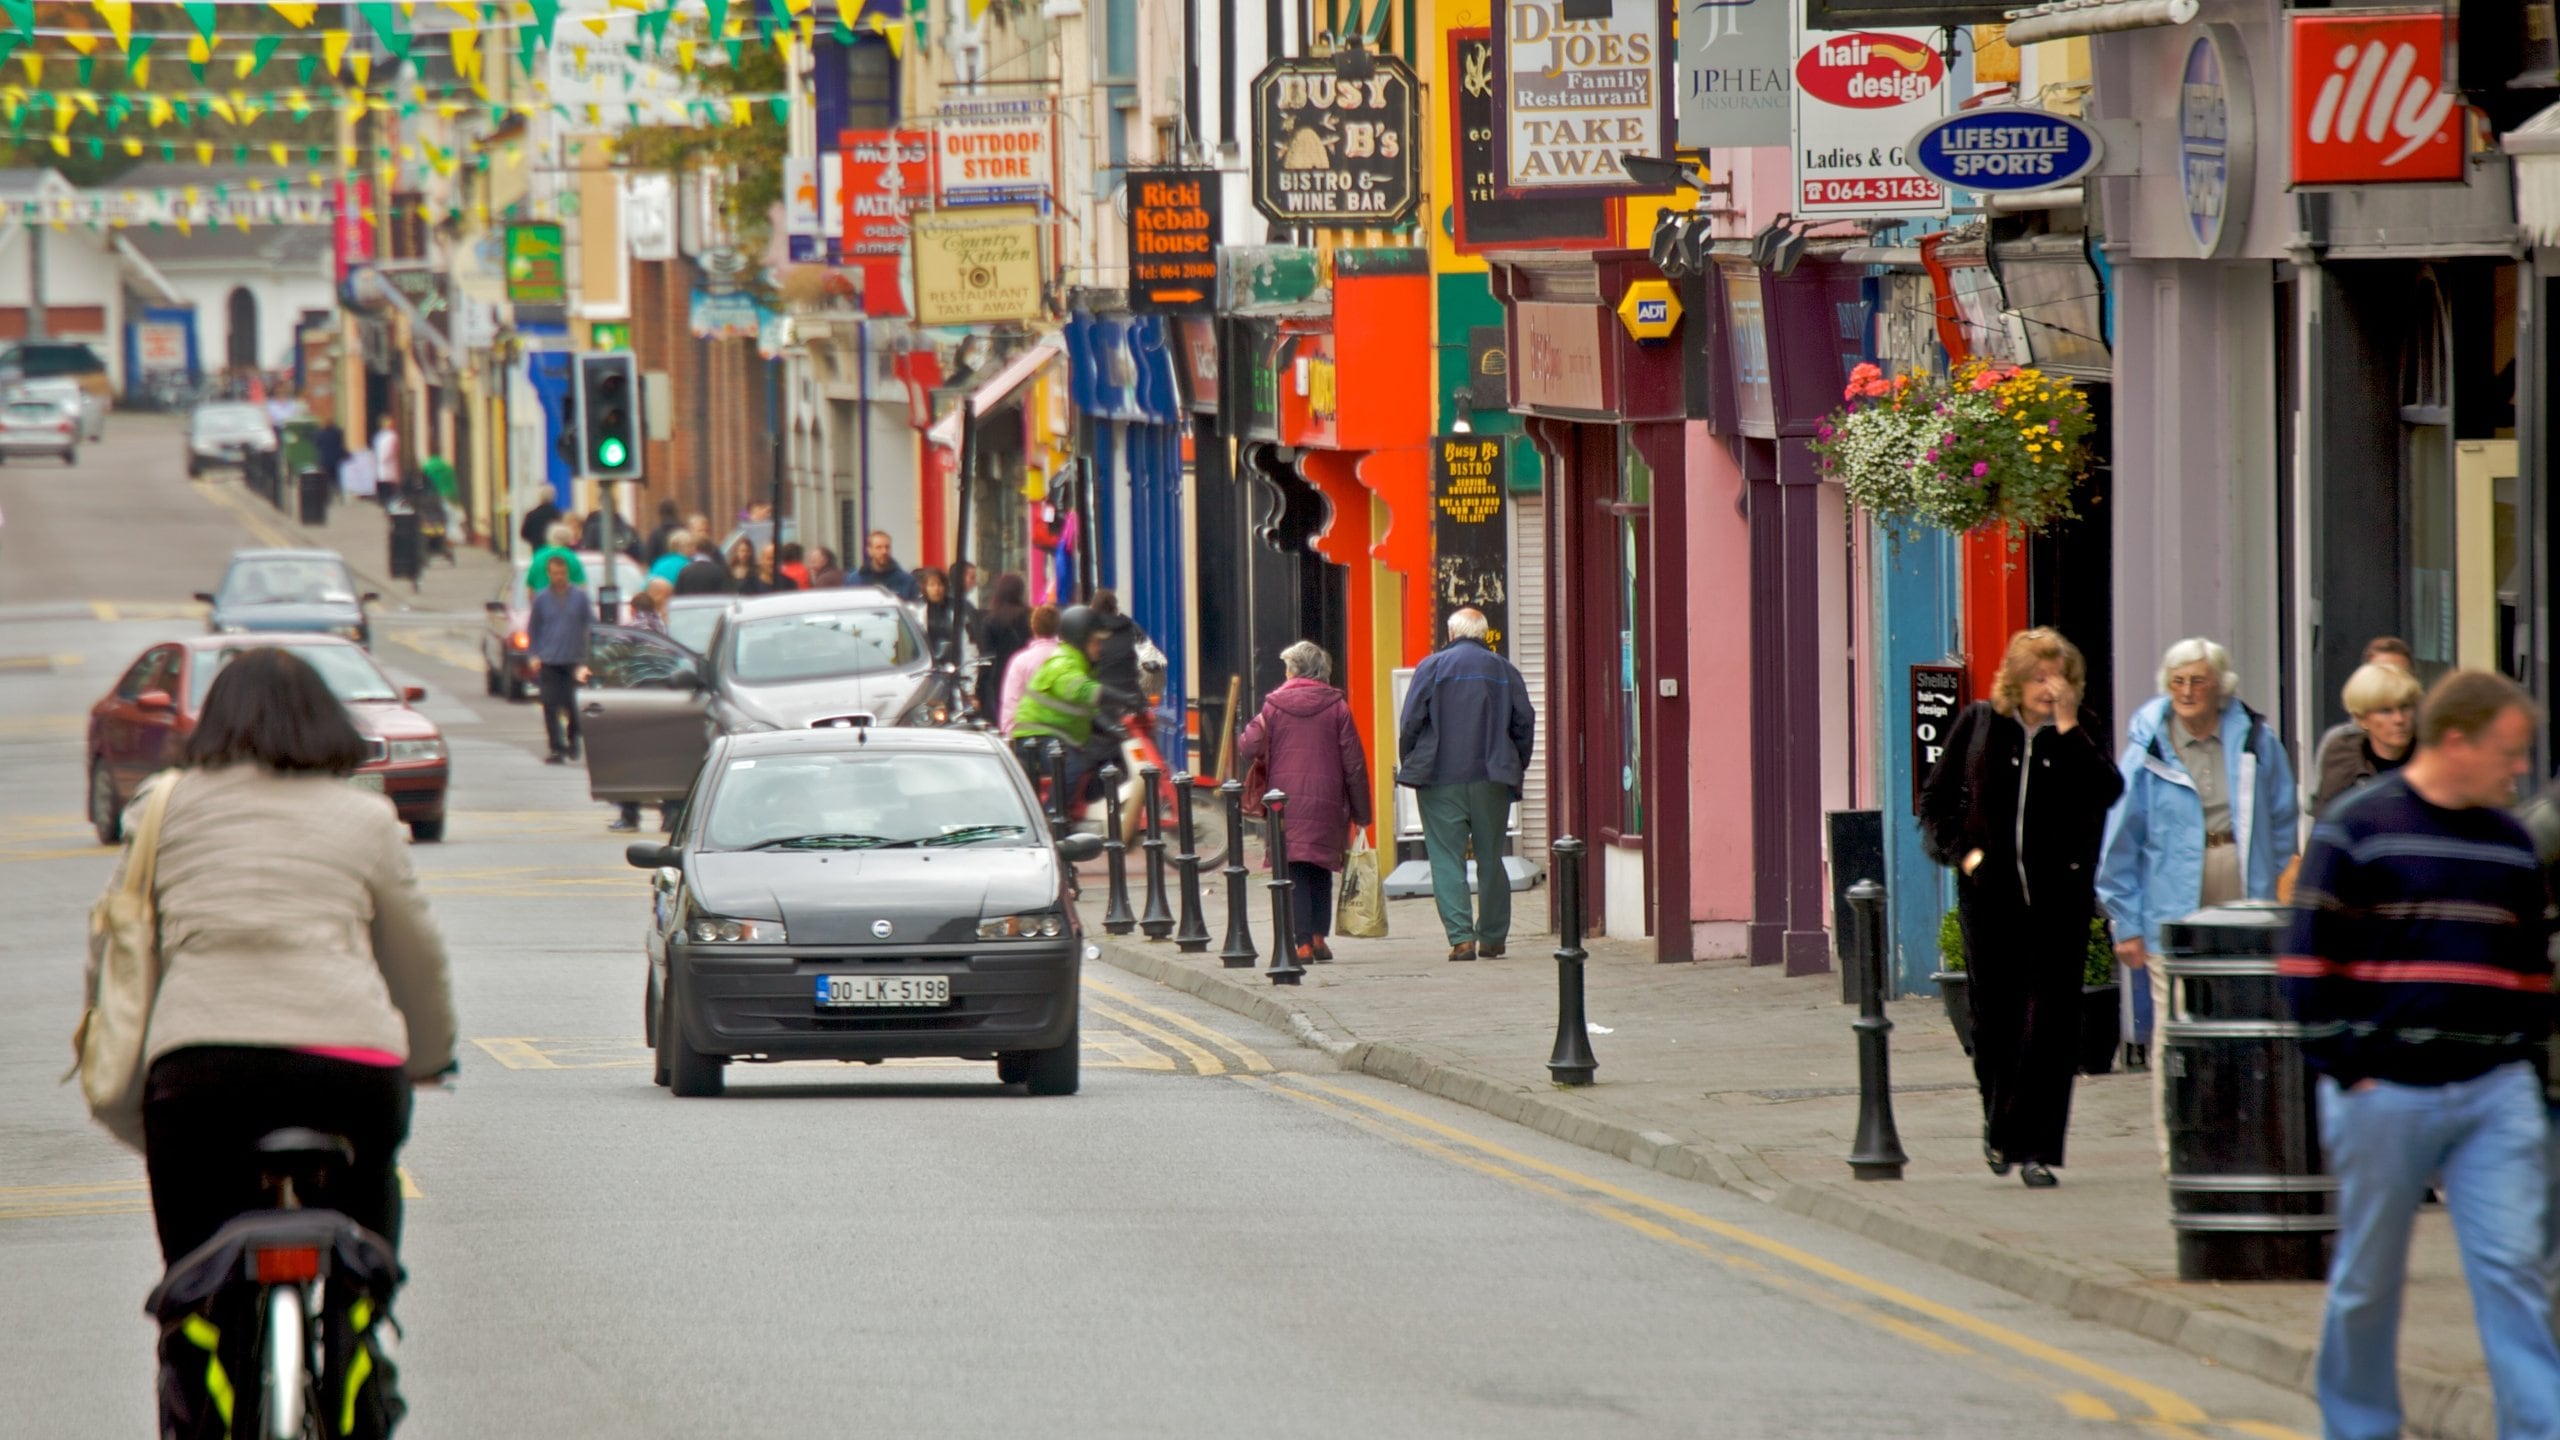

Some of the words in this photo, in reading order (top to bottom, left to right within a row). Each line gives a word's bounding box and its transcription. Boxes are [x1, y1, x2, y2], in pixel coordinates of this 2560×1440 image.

[1541, 33, 1651, 78] JOES
[1819, 39, 1873, 67] hair
[1567, 71, 1648, 90] Family
[1847, 71, 1932, 102] design
[1277, 73, 1393, 110] BUSY
[1518, 89, 1649, 107] Restaurant
[1700, 95, 1790, 110] INSURANC
[2307, 40, 2457, 167] illy
[1344, 121, 1400, 159] B's
[1523, 116, 1644, 146] TAKE
[1941, 127, 2069, 150] LIFESTYLE
[964, 157, 1031, 179] STORE
[1520, 148, 1650, 177] AWA
[1806, 149, 1863, 169] Ladies
[1868, 147, 1883, 166] &
[1952, 154, 2054, 176] SPORTS
[1279, 171, 1353, 191] BISTRO
[1827, 179, 1941, 200] 064-31433
[1143, 181, 1200, 207] Ricki
[1287, 192, 1337, 211] WINE
[1346, 191, 1387, 210] BAR
[1135, 207, 1210, 231] Kebab
[942, 233, 1020, 253] Country
[1136, 230, 1210, 254] House
[957, 246, 1031, 267] Kitchen
[1137, 264, 1159, 280] Tel:
[1160, 264, 1181, 279] 064
[929, 287, 1029, 303] RESTAURANT
[936, 304, 973, 316] TAKE
[982, 301, 1026, 313] AWAY
[1638, 303, 1667, 320] ADT
[1445, 441, 1478, 462] Busy
[1450, 461, 1492, 475] BISTRO
[1917, 672, 1958, 689] Sheila's
[1917, 690, 1936, 702] hair
[1917, 704, 1949, 717] design
[831, 981, 948, 1000] 00-LK-5198
